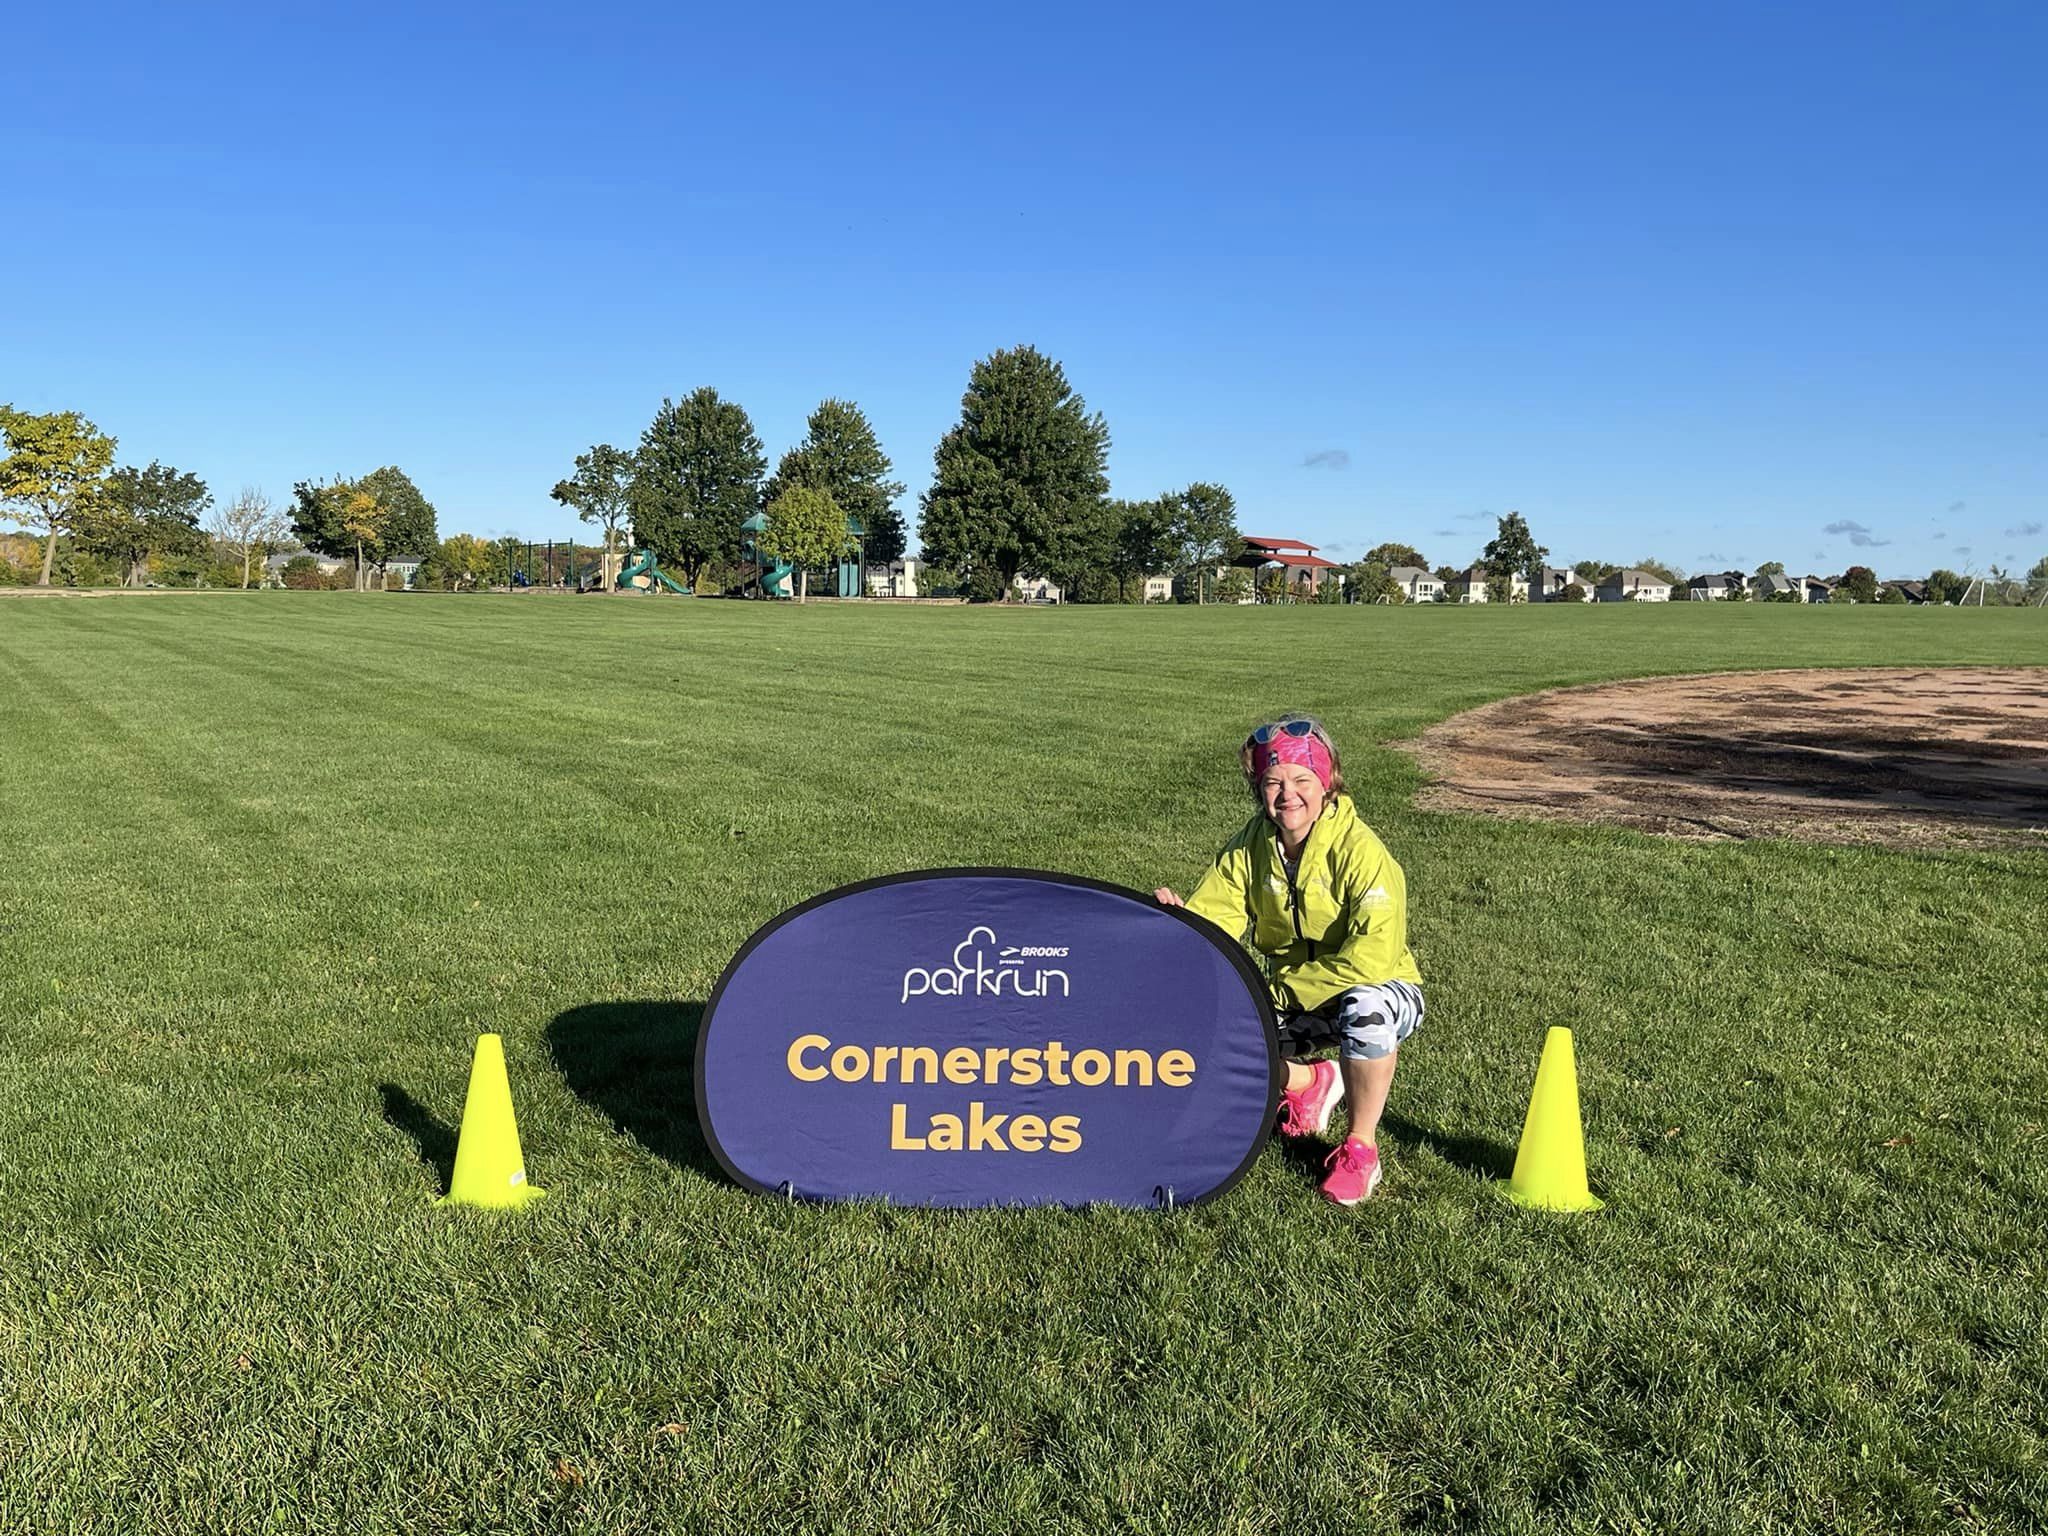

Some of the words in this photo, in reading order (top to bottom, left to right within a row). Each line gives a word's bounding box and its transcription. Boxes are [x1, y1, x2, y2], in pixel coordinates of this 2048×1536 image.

[901, 949, 1070, 1004] parkrun
[1020, 946, 1070, 957] BROOKS
[786, 1034, 1196, 1087] Cornerstone
[890, 1101, 1083, 1153] Lakes
